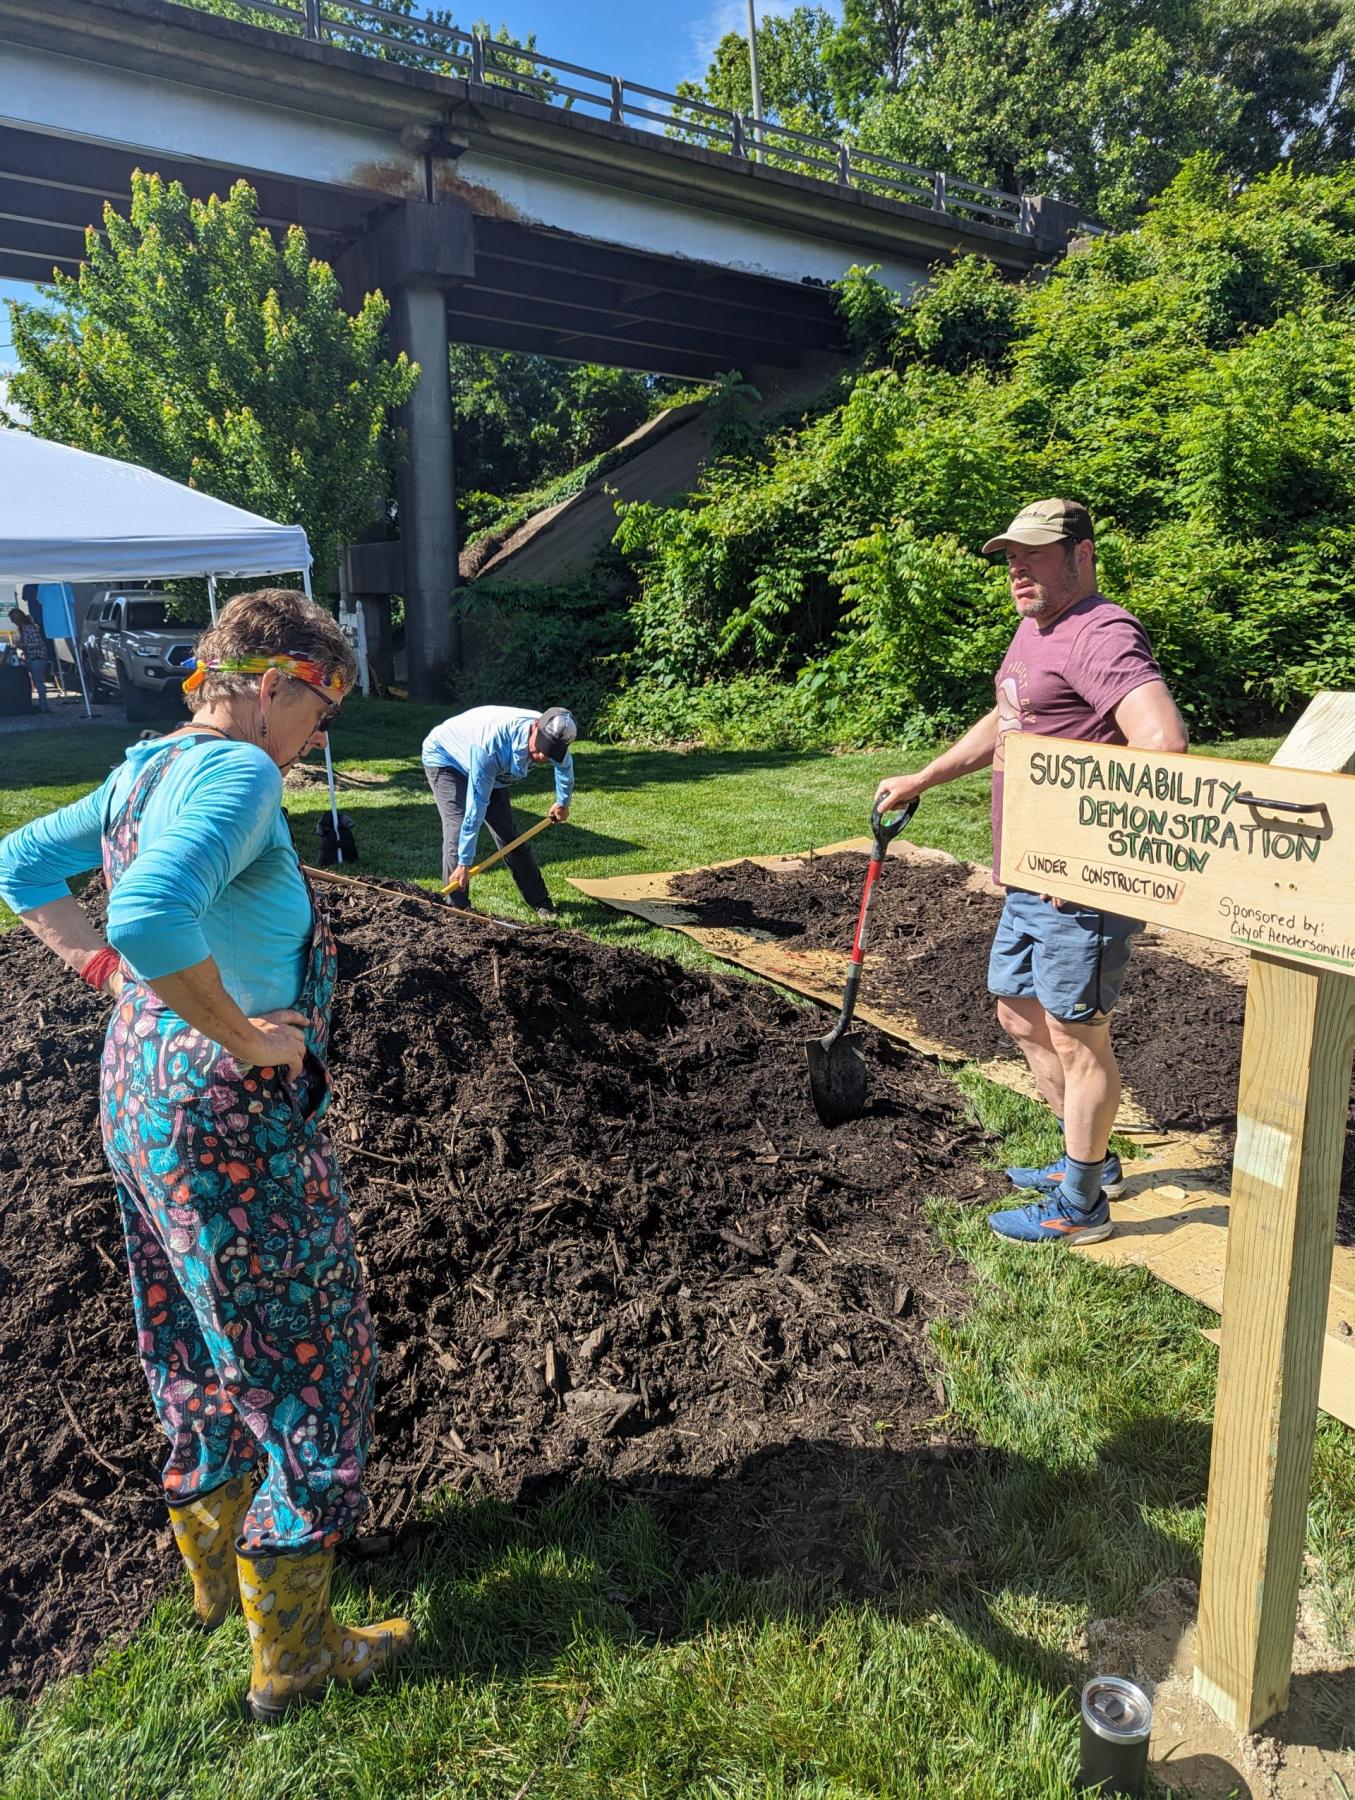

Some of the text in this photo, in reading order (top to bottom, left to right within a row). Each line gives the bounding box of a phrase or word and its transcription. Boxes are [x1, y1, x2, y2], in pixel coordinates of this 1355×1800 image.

[1029, 752, 1242, 815] SUSTAINABILITY
[1078, 795, 1322, 864] DEMONSTRATION
[1107, 830, 1211, 874] STATION
[1027, 855, 1179, 901] UNDER CONSTRUCTION
[1218, 896, 1325, 937] Sponsored by:
[1268, 926, 1355, 960] Hendersonville
